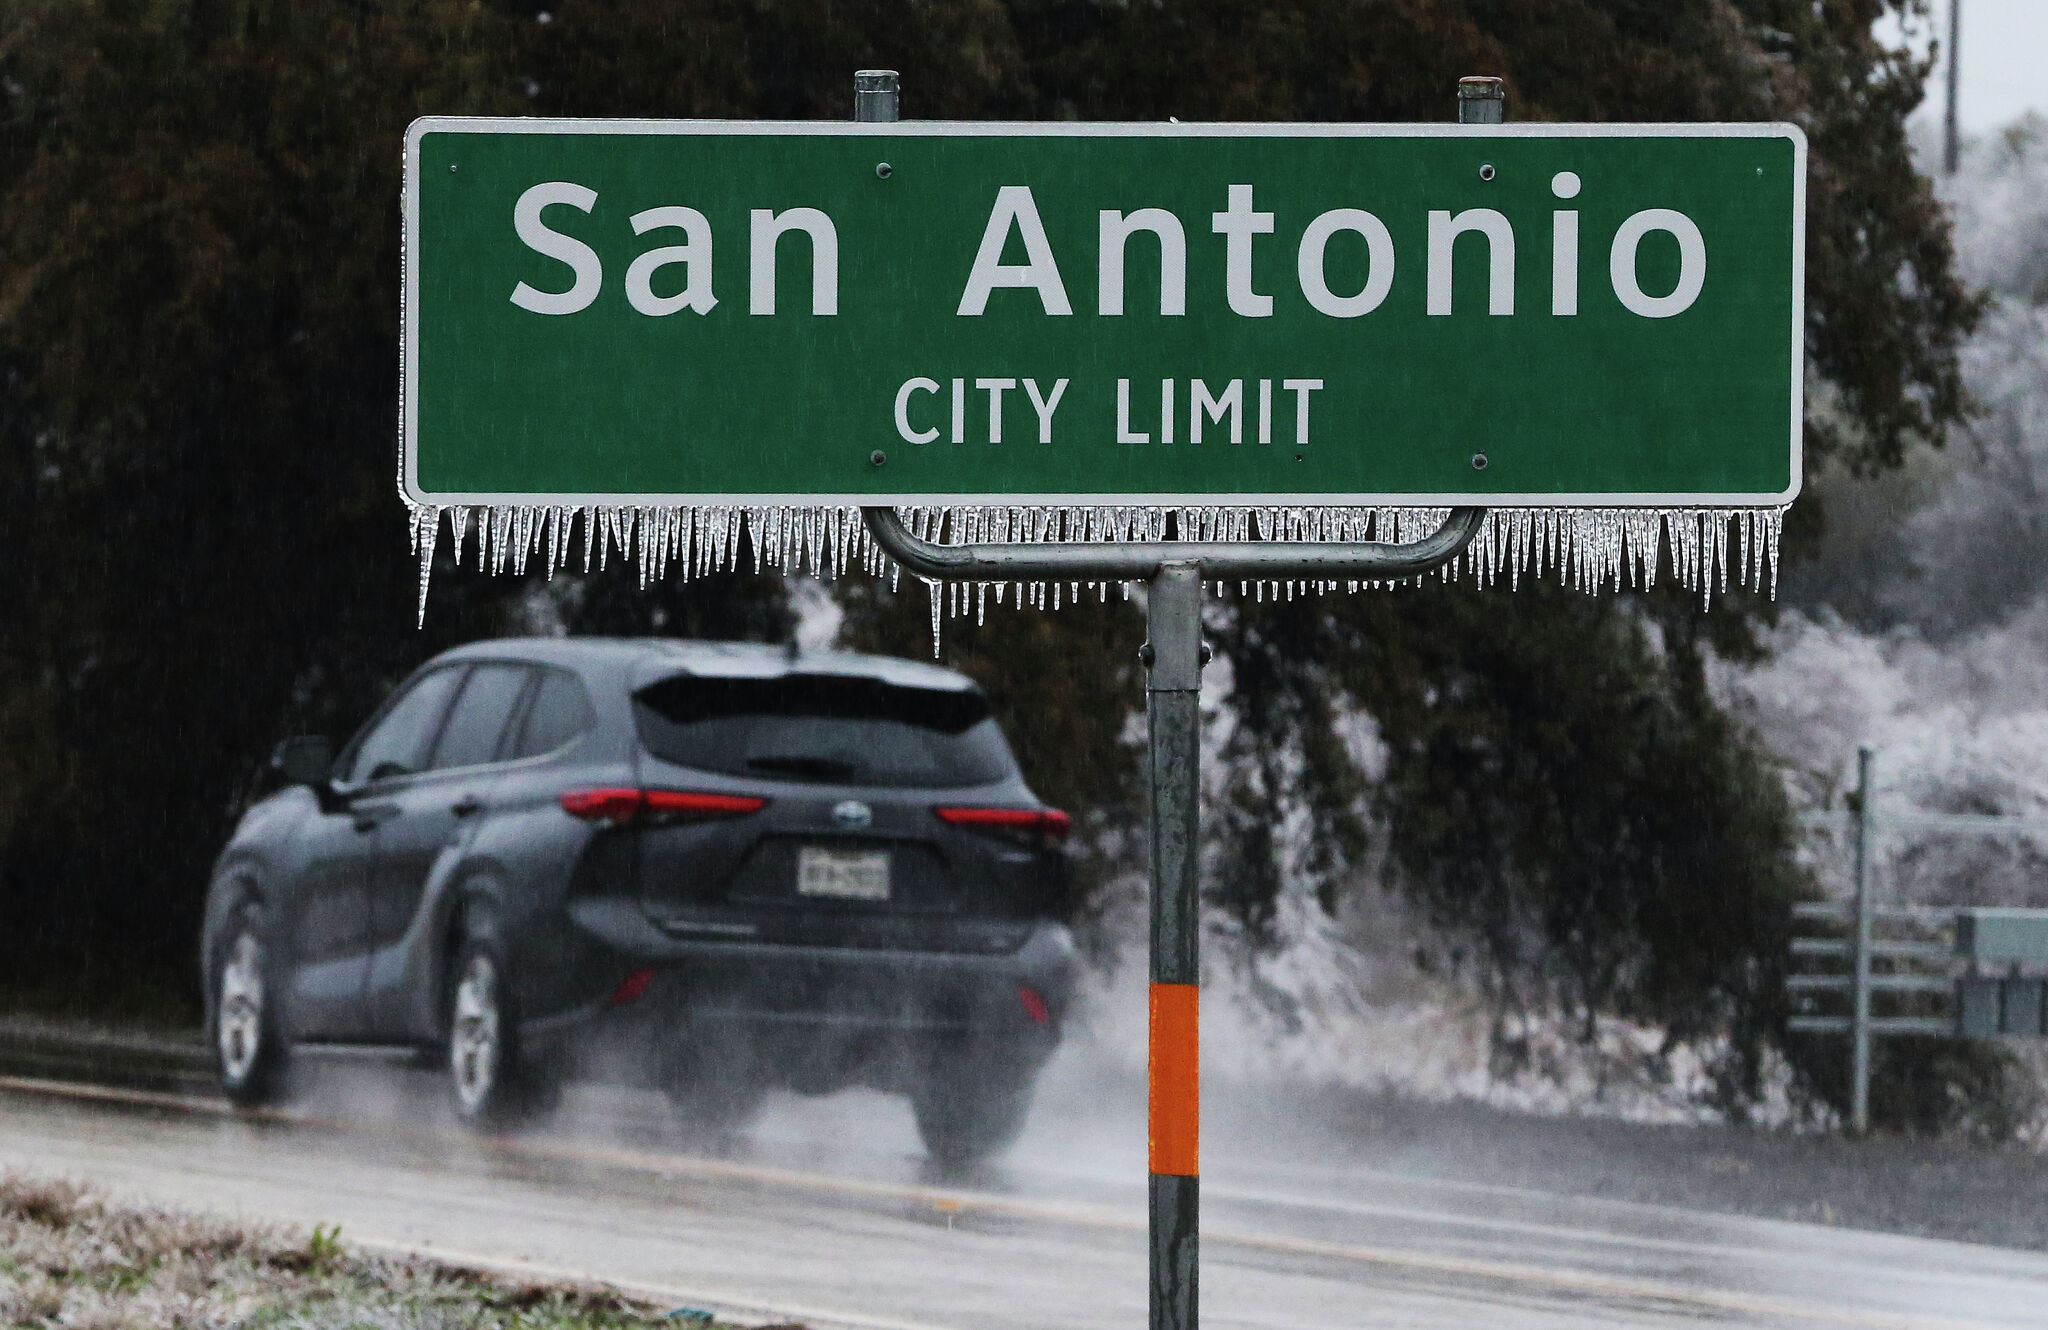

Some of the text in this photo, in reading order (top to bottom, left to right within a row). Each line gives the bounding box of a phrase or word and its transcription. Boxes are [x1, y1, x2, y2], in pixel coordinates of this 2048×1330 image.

[510, 172, 1706, 318] San Antonio
[895, 377, 1323, 444] CITY LIMIT
